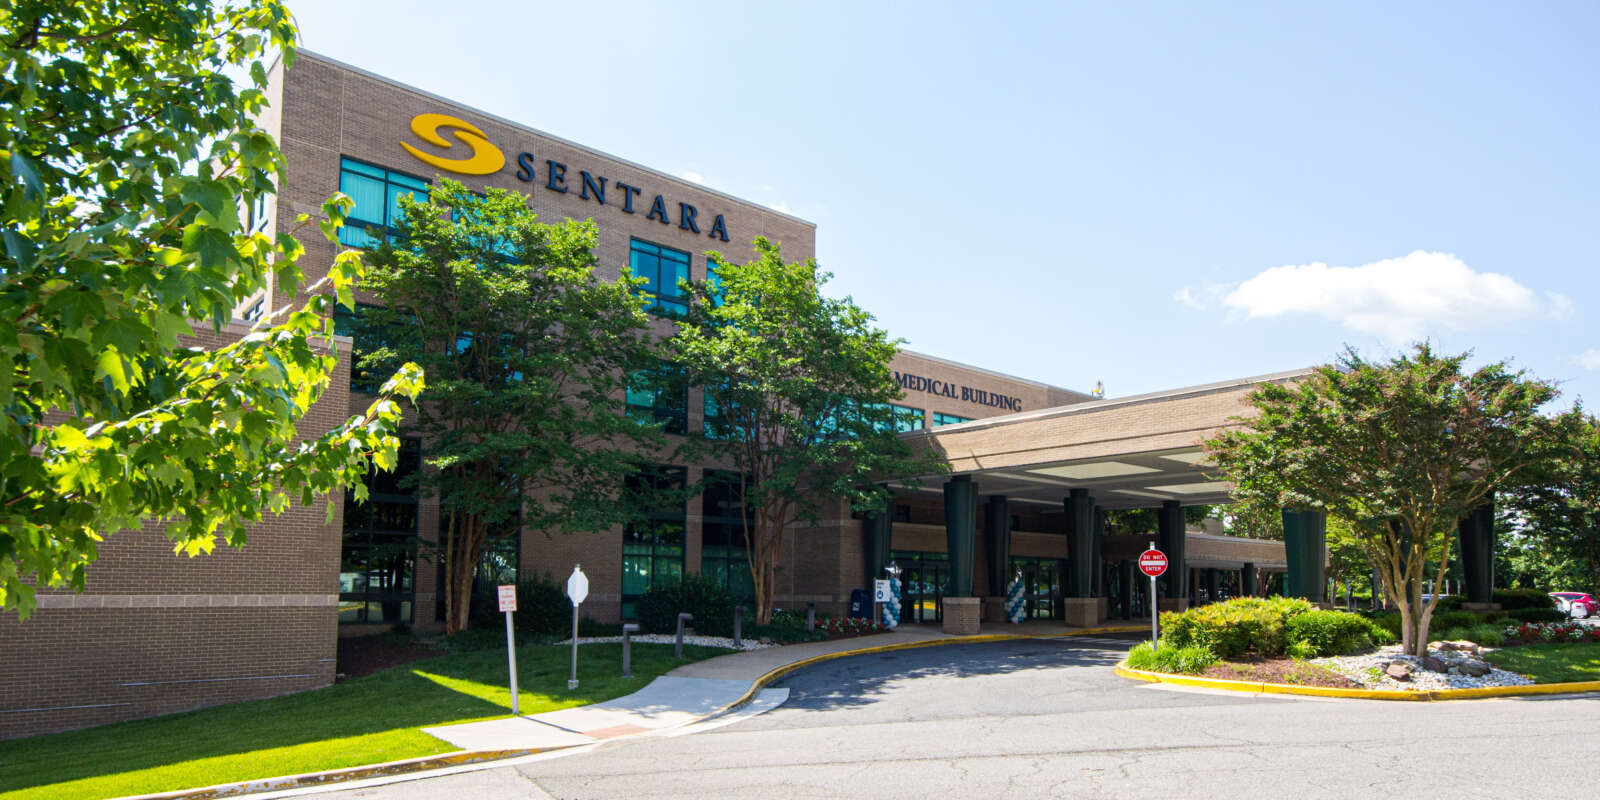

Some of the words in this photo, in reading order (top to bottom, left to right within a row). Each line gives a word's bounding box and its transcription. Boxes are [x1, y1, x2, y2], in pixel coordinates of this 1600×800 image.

[516, 152, 730, 242] SENTARA
[895, 371, 958, 399] MEDICAL
[961, 386, 1022, 412] BUILDING
